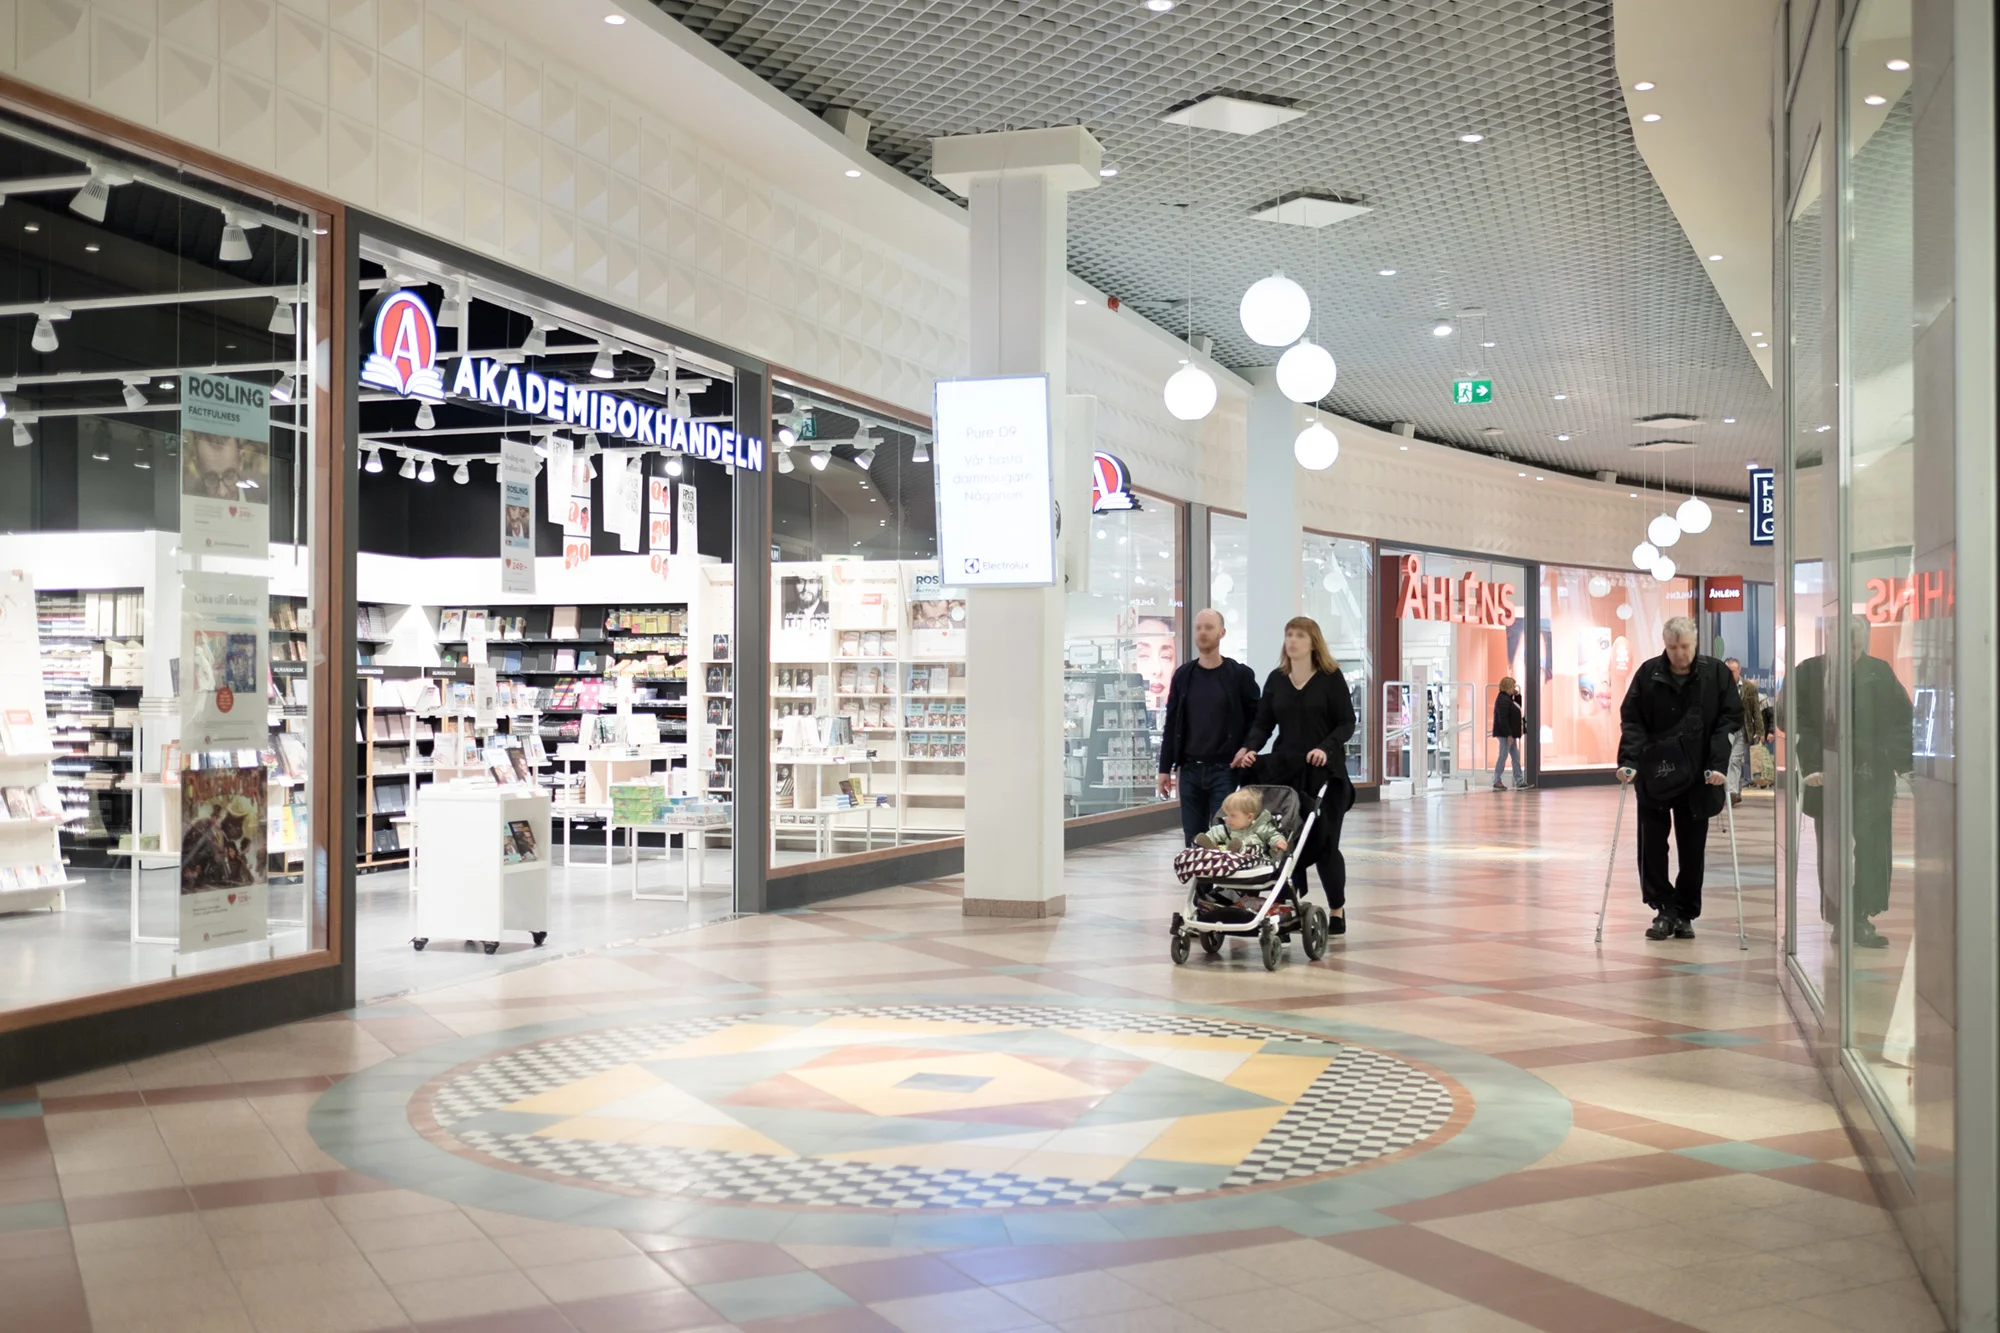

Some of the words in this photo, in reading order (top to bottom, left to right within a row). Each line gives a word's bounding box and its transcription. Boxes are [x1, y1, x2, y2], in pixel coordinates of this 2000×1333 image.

[188, 376, 264, 409] ROSLING
[188, 406, 241, 423] FACTFULNESS
[452, 354, 763, 472] AKADEMIBOKHANDELN
[982, 561, 1029, 570] Electrolux
[1395, 553, 1516, 627] ÅHLÉNS
[1709, 588, 1740, 599] ÅHLÉNS
